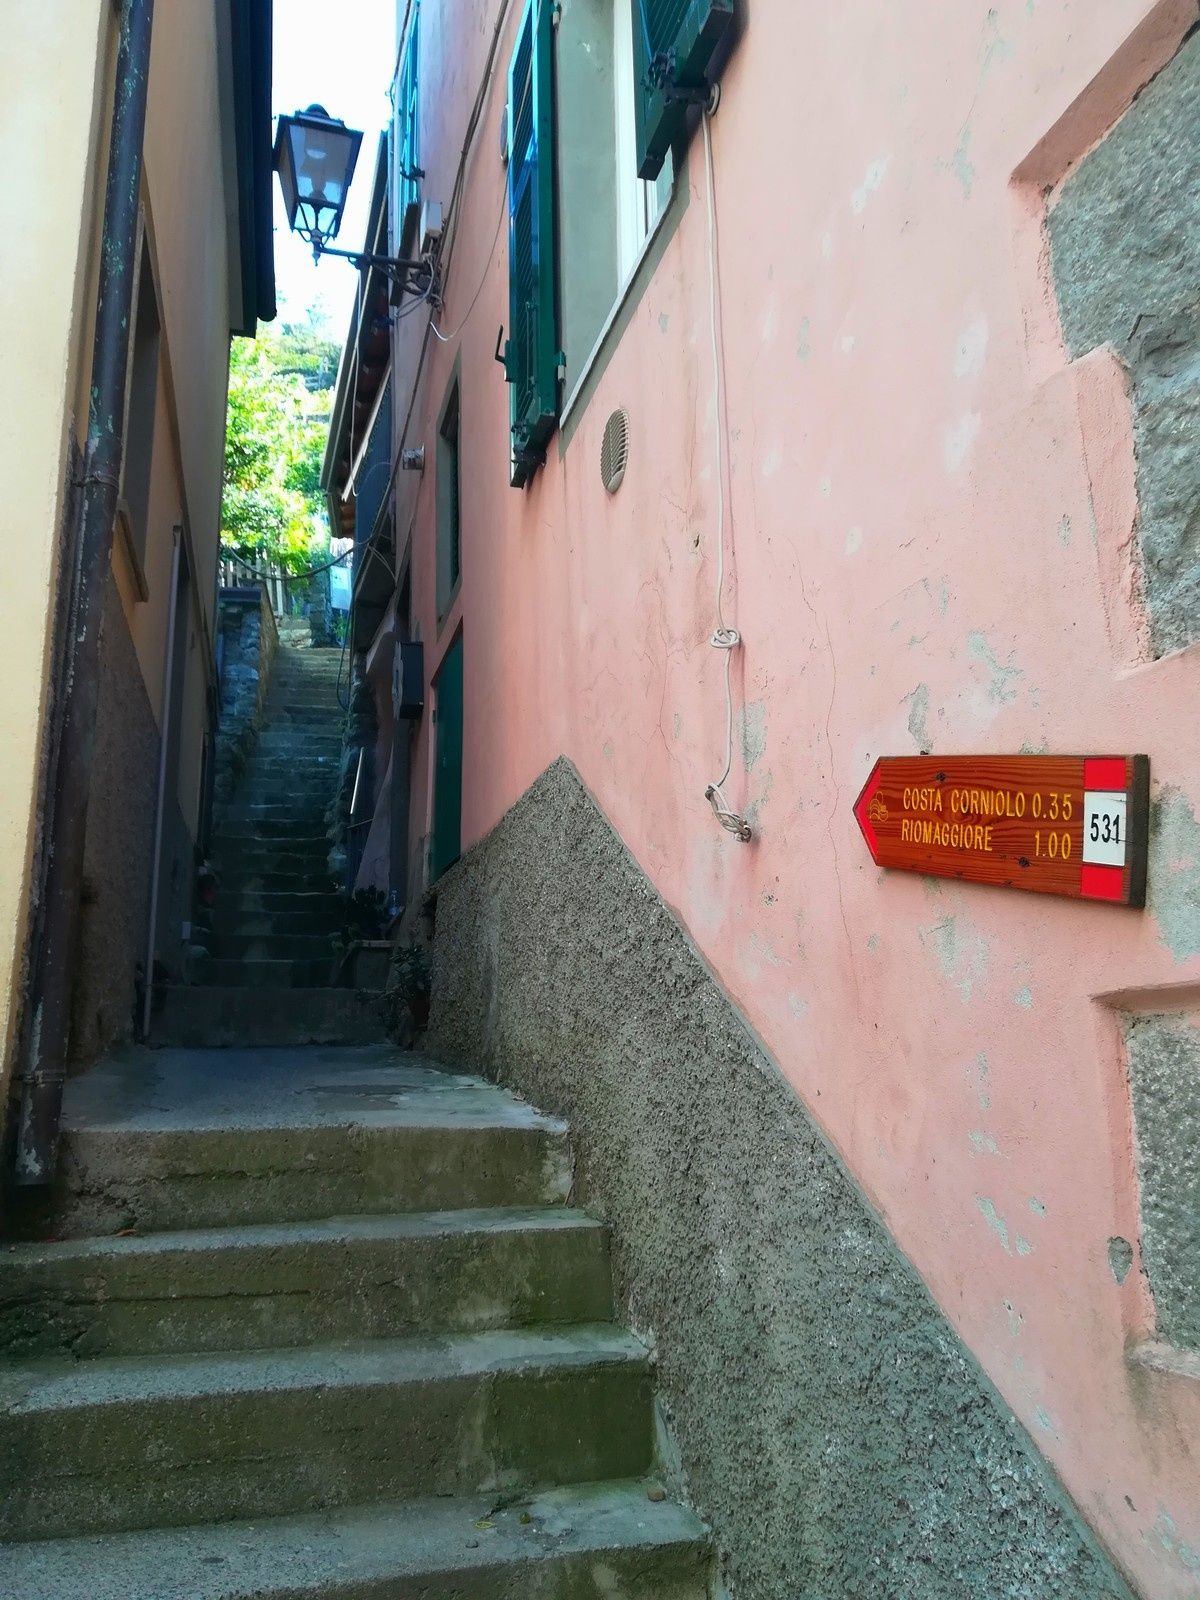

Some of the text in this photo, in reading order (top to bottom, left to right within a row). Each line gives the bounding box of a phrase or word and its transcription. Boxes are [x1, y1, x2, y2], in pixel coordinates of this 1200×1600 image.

[903, 787, 1073, 821] COSTA CORNIOLO 0.35
[901, 819, 1071, 859] RIOMAGGIORE 1.00
[1090, 813, 1121, 845] 531
